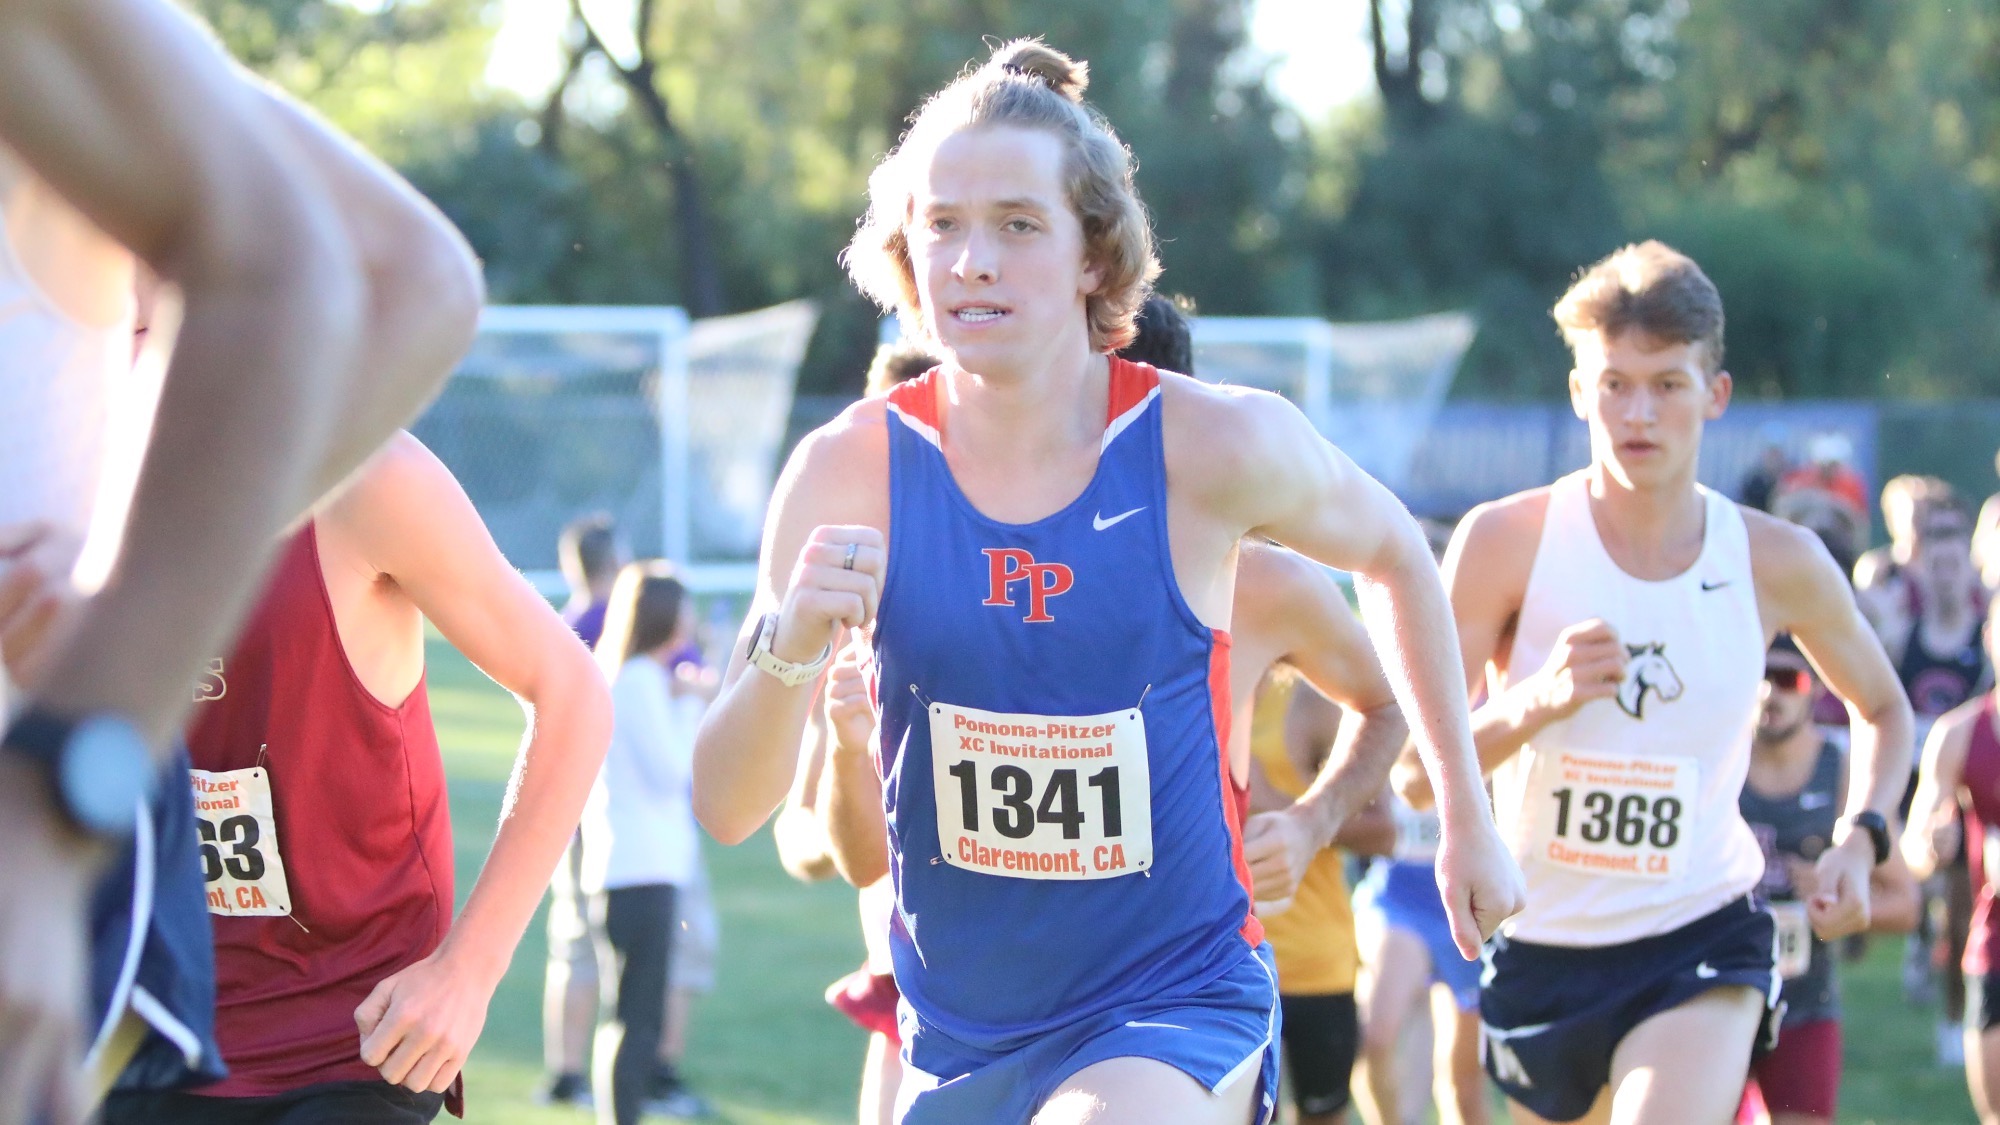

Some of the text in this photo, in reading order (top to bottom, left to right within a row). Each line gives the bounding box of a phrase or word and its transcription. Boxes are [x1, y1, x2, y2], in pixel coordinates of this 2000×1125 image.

[982, 547, 1073, 623] PP
[954, 713, 1116, 741] Pomona-Pitzer
[959, 736, 1113, 759] XC Invitational
[949, 760, 1122, 840] 1341
[1552, 787, 1682, 849] 1368
[958, 836, 1126, 877] Claremont, CA
[1646, 854, 1669, 874] CA
[236, 886, 267, 909] CA
